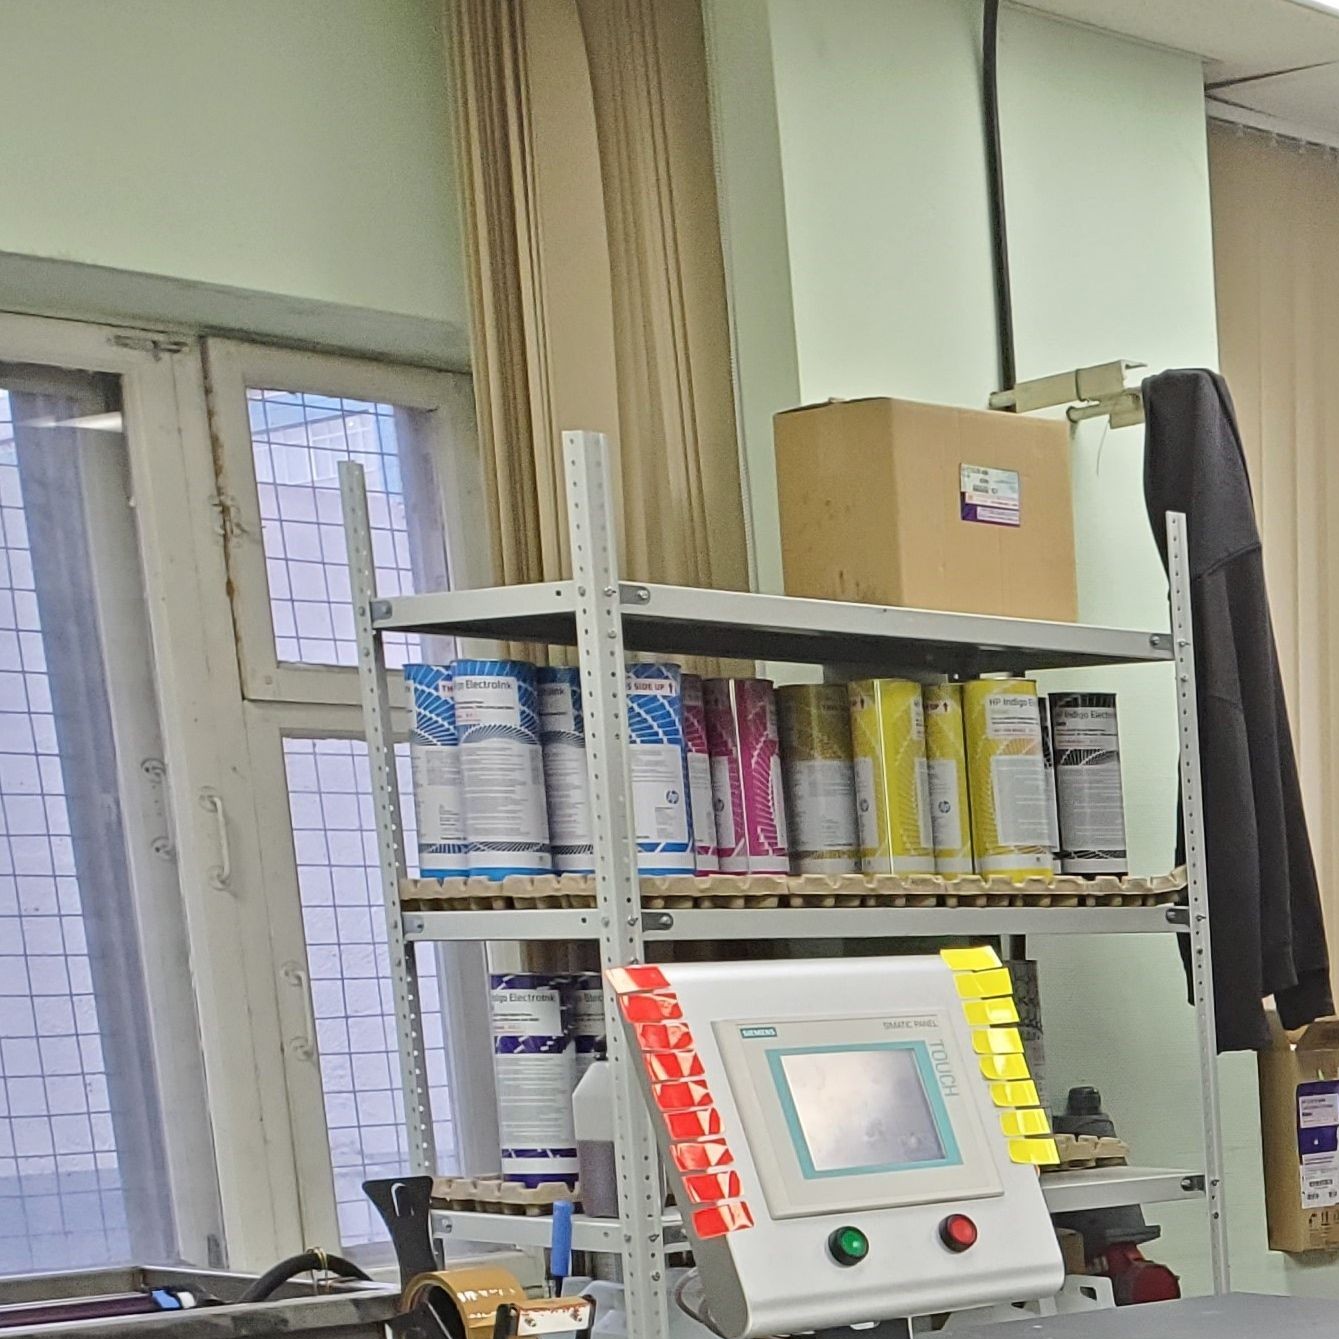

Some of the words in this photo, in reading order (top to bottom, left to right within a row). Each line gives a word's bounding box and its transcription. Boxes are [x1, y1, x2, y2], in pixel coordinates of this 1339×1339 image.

[883, 1021, 913, 1030] SIMATIC
[741, 1028, 777, 1037] SIEMENS
[929, 1038, 960, 1098] TOUCH
